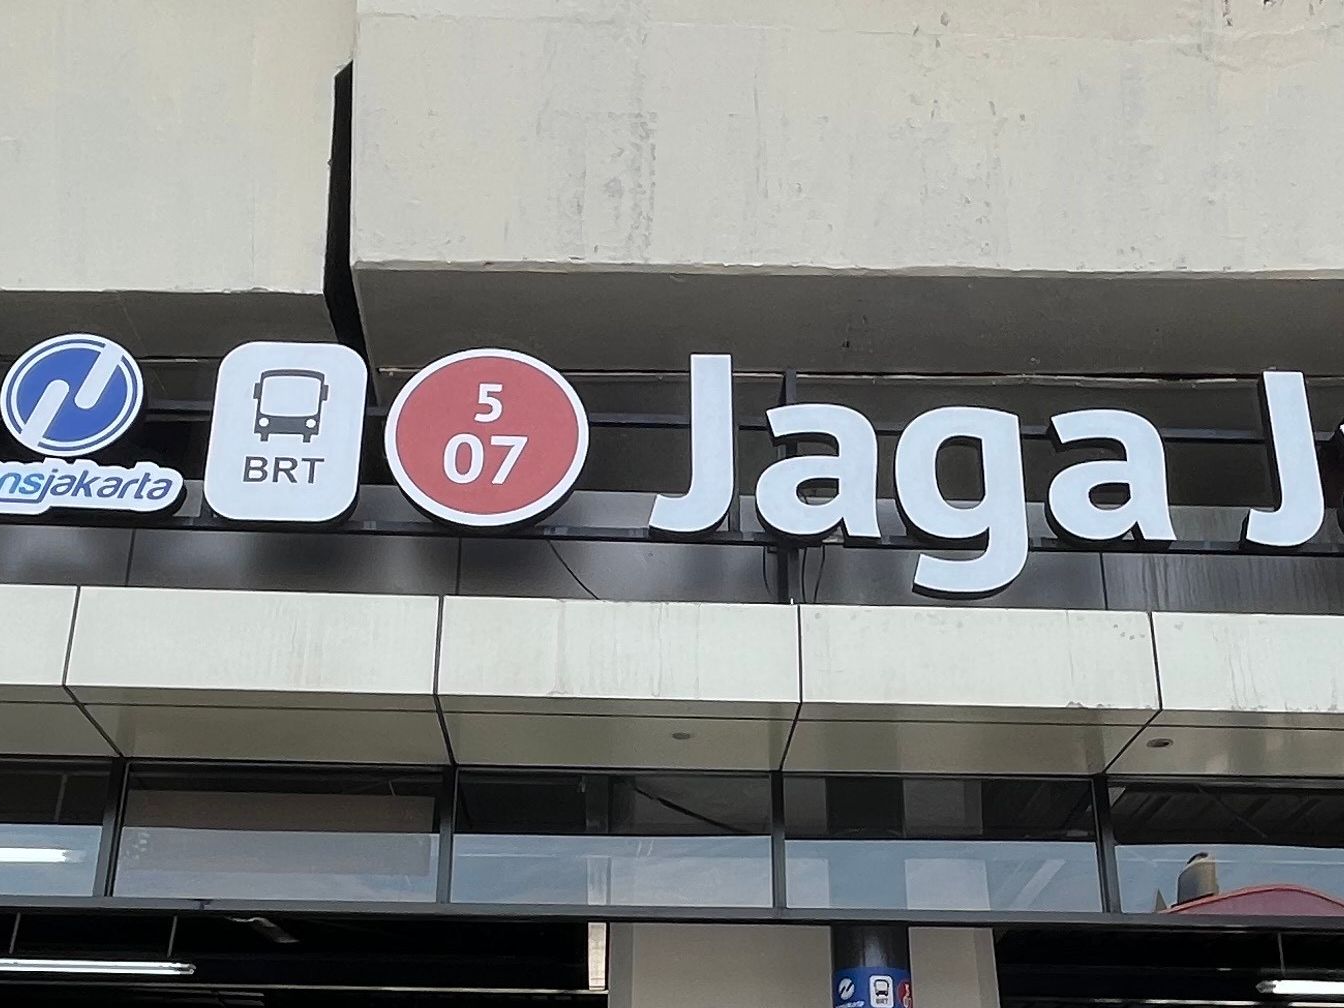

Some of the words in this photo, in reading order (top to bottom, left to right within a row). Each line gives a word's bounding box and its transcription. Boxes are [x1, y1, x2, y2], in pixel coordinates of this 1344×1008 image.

[474, 383, 503, 422] 5
[242, 455, 325, 484] BRT
[443, 434, 529, 484] 07
[650, 353, 1181, 592] Jaga
